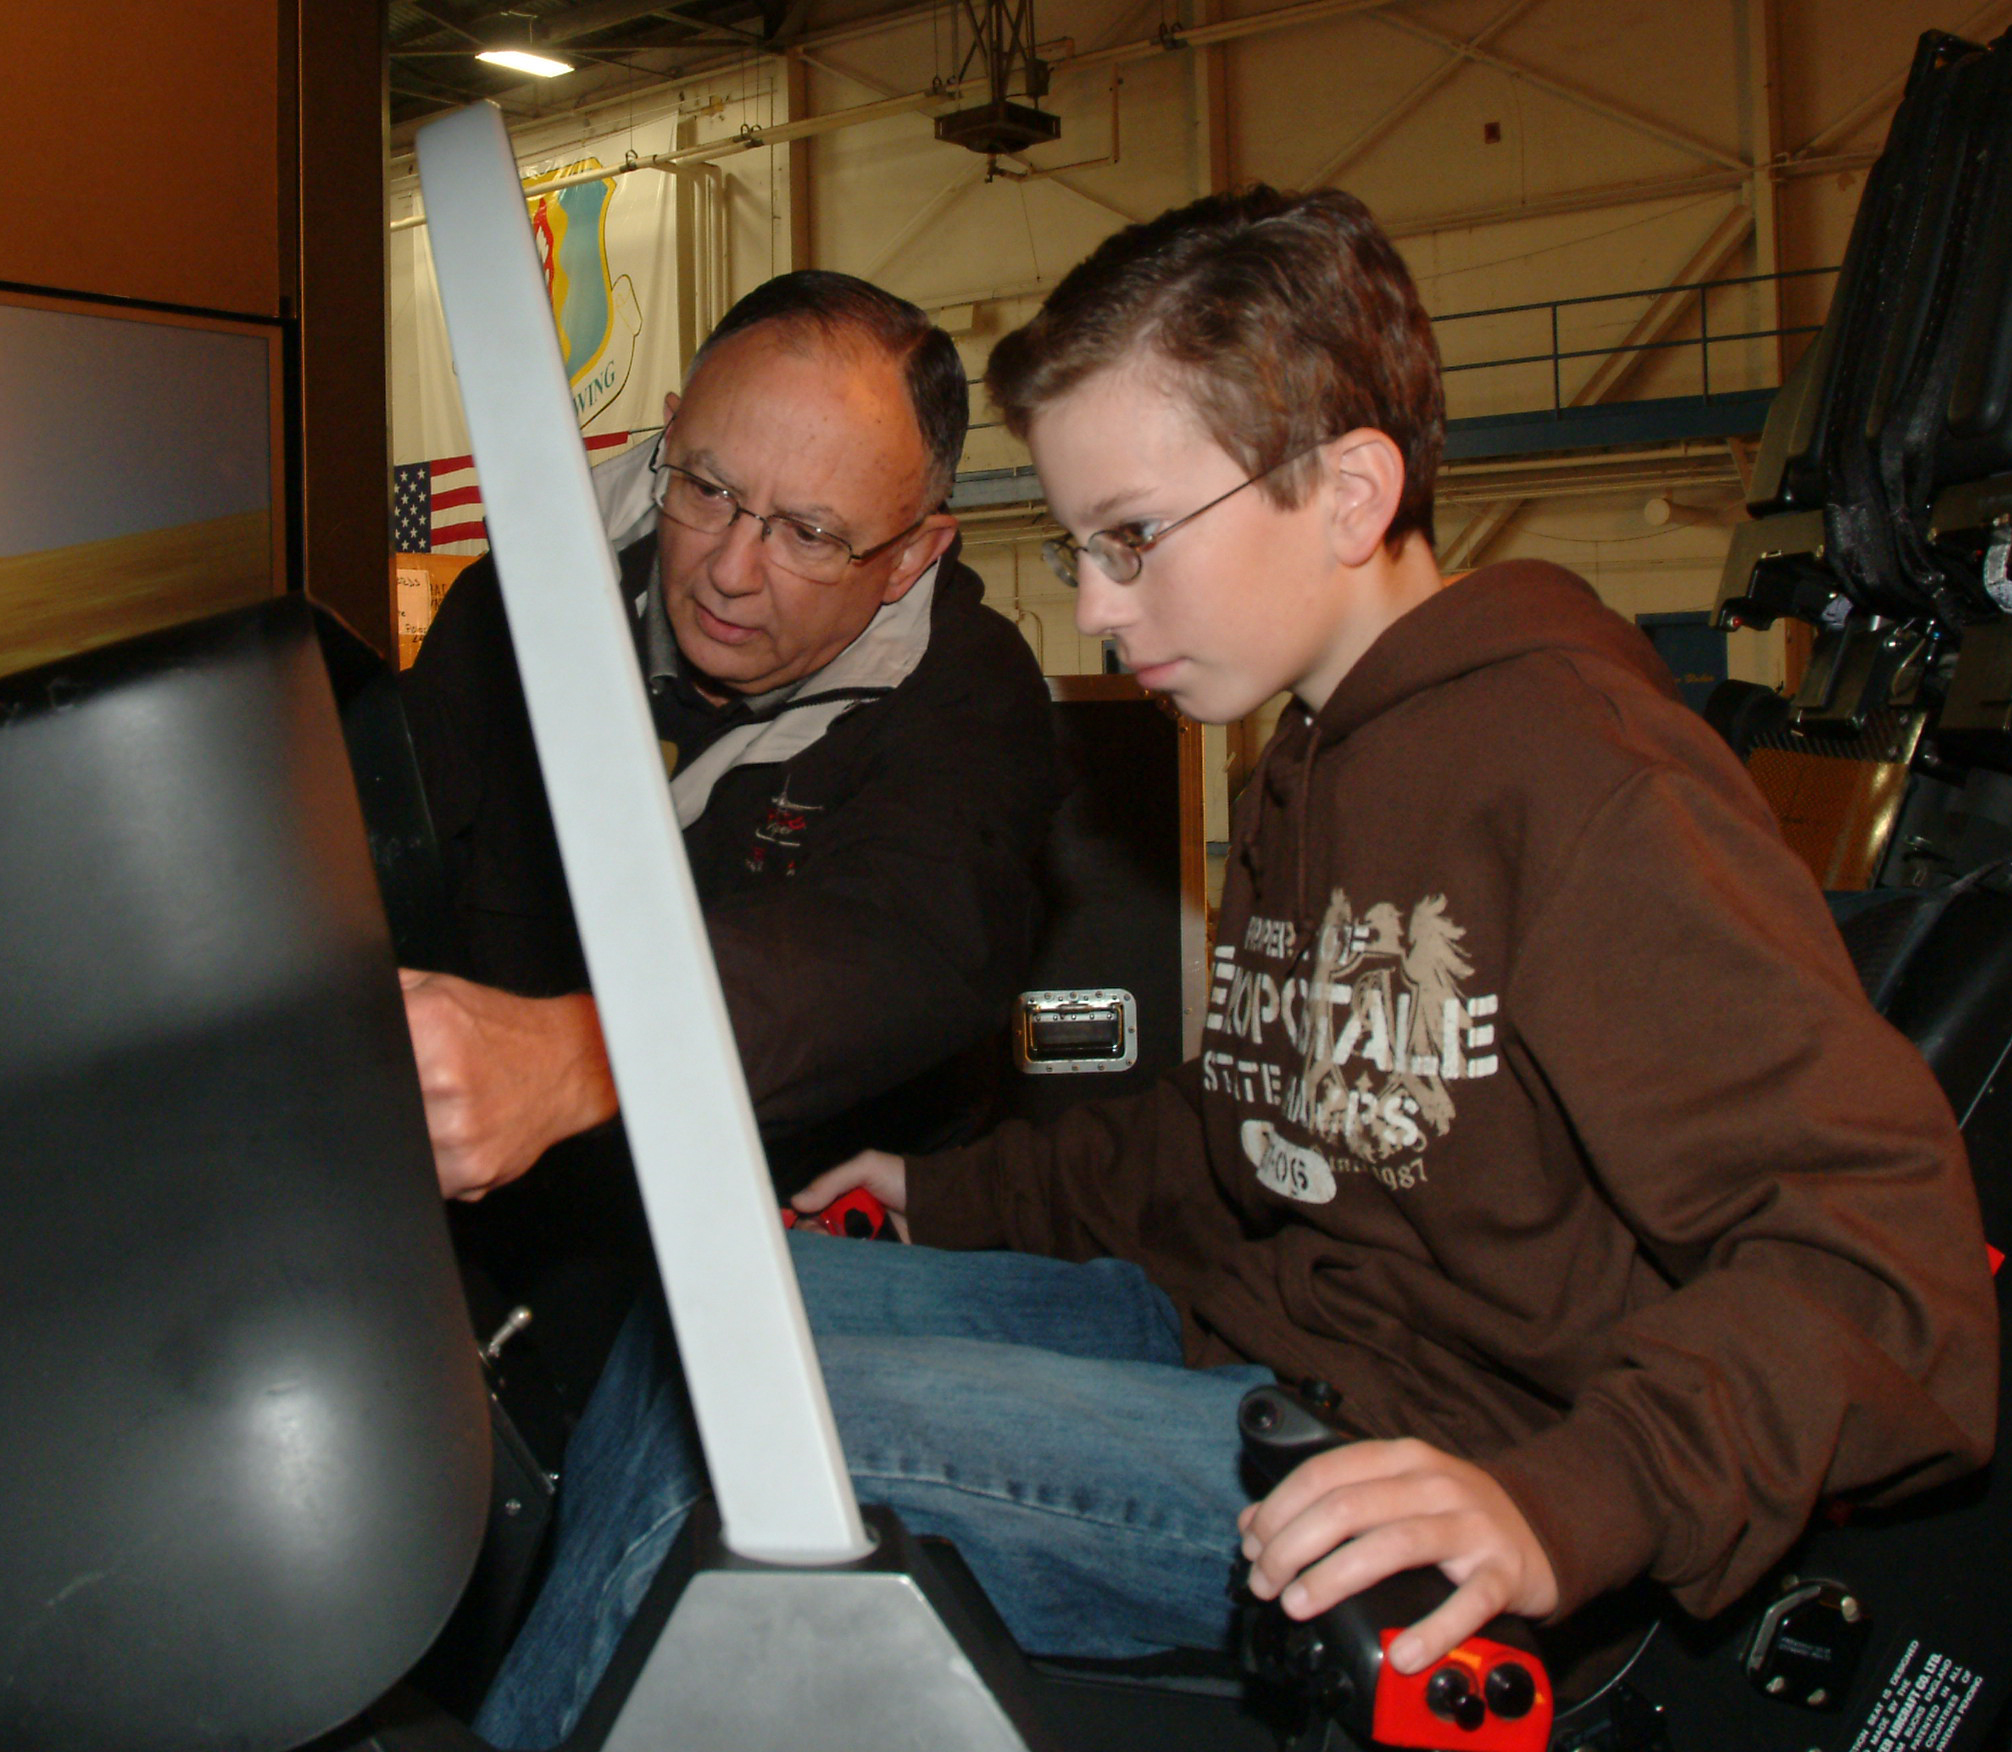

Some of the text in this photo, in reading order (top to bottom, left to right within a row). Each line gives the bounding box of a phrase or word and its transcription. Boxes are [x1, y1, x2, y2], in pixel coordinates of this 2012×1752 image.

[573, 360, 615, 416] WING
[1867, 1702, 1884, 1726] SEAT
[1882, 1688, 1892, 1699] IS
[1889, 1639, 1919, 1686] DESIGNED
[1870, 1678, 1911, 1745] MADE BY THE
[1888, 1688, 1922, 1739] AIRCRAFT
[1915, 1674, 1931, 1691] CO.
[1924, 1653, 1943, 1674] LTD.
[1904, 1705, 1926, 1738] BUCKS
[1923, 1658, 1952, 1702] ENGLAND
[1910, 1666, 1963, 1750] PATENTED IN ALL
[1925, 1670, 1972, 1748] COUNTRIES OF
[1936, 1675, 1983, 1752] PATENTS PENDING
